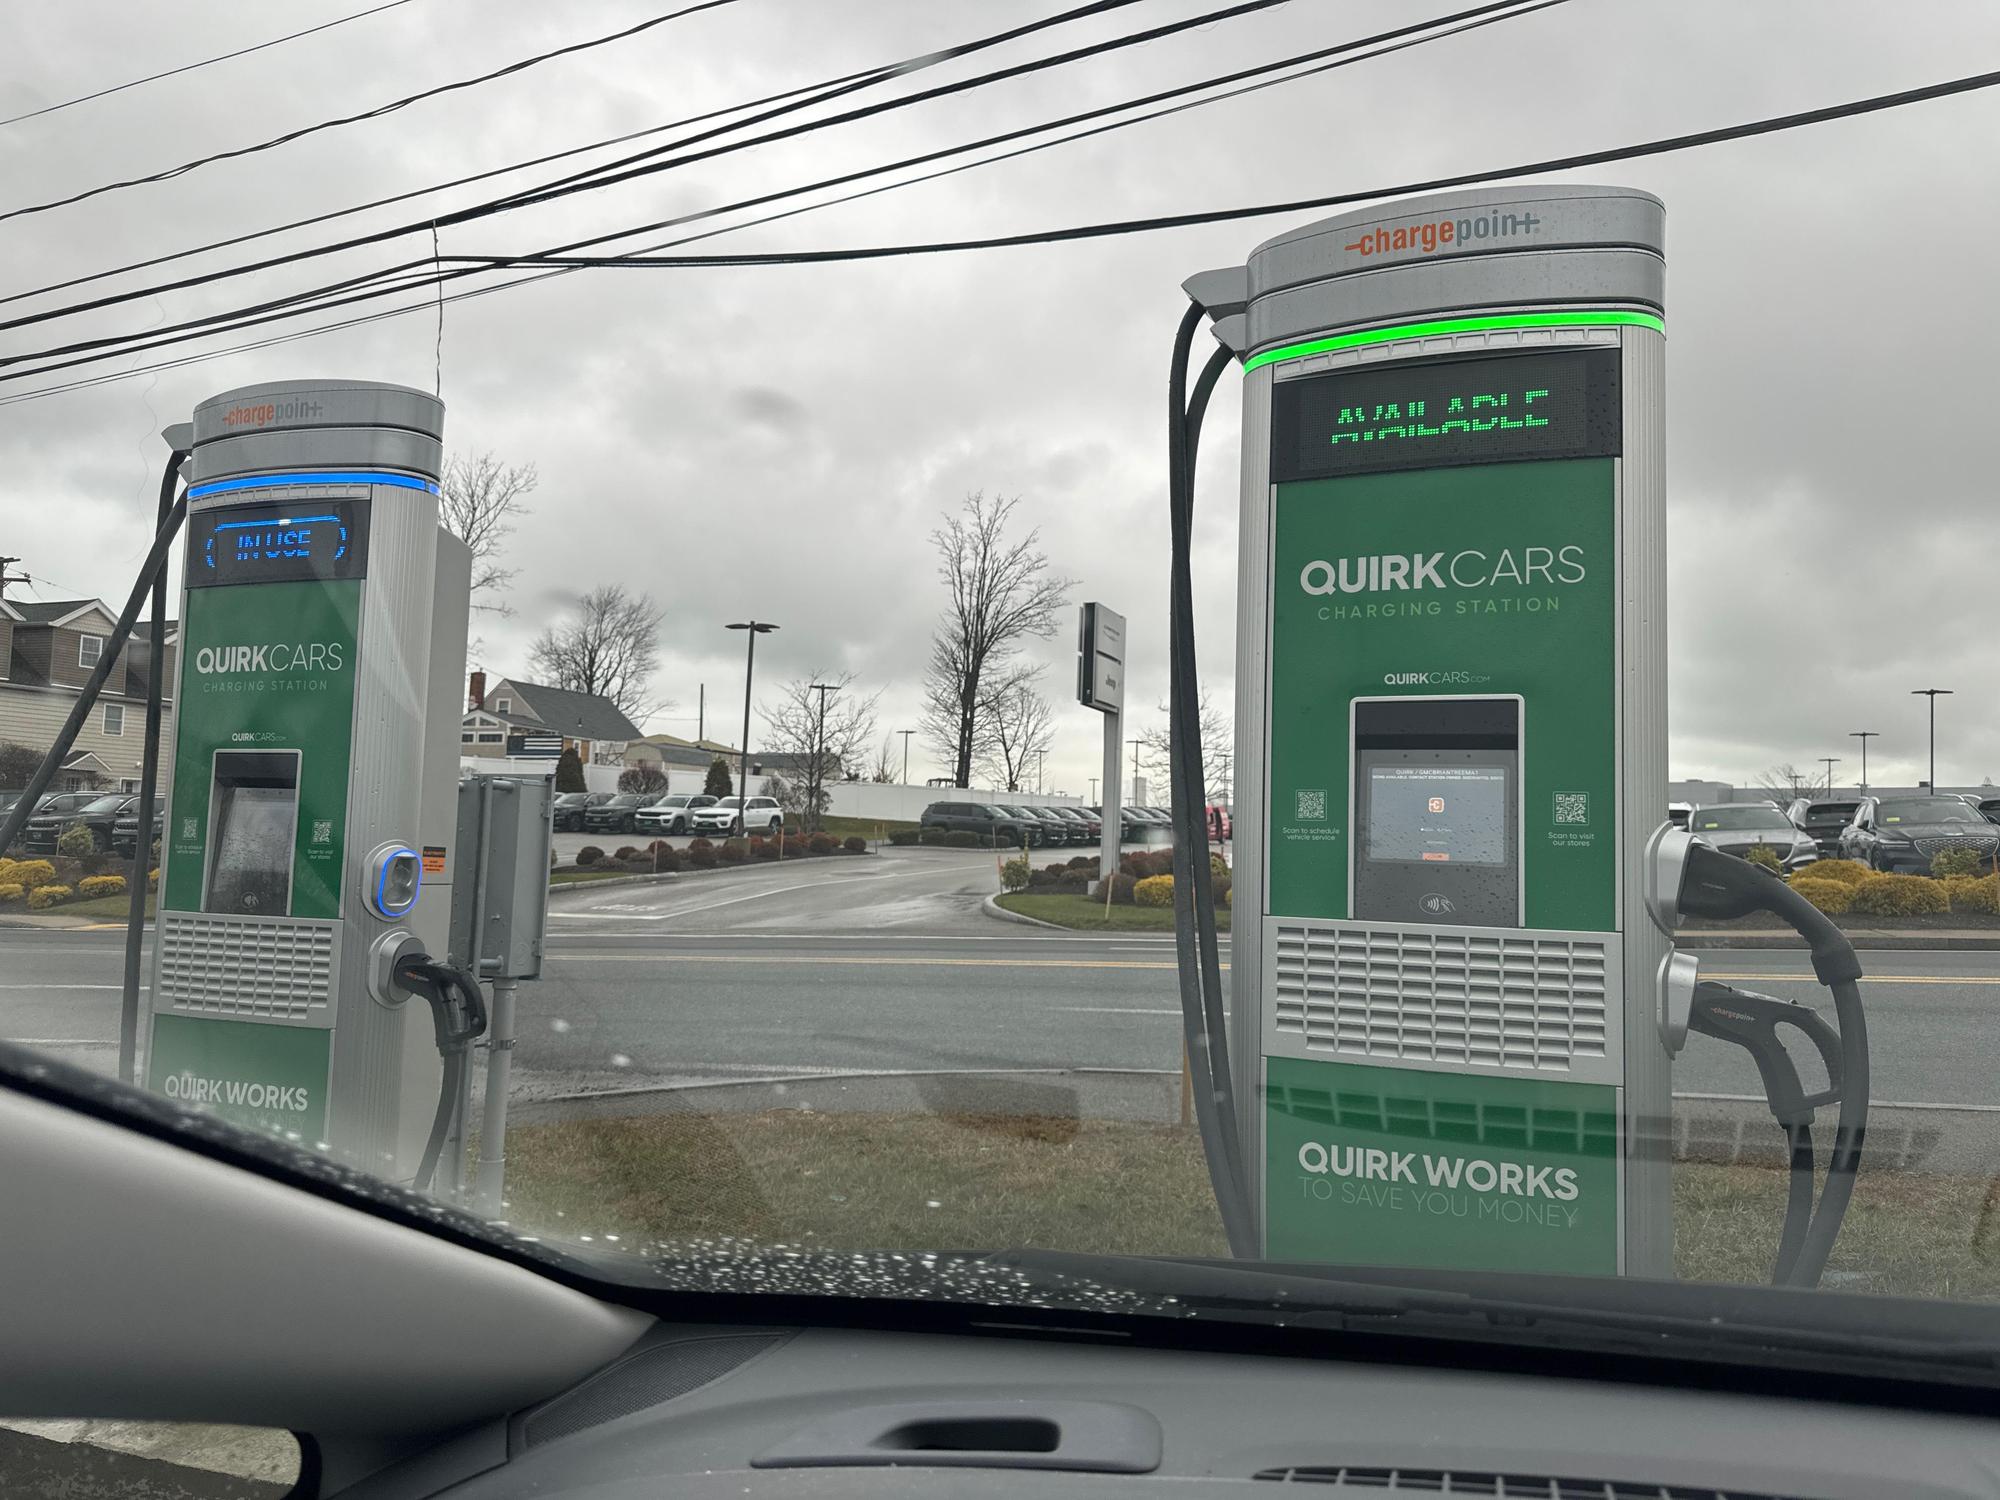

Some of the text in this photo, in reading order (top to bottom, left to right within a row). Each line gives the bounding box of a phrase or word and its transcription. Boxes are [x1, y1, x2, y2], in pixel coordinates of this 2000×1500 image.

[1300, 545, 1586, 596] QUIRKCARS
[1318, 597, 1560, 621] CHARGING STATION
[203, 679, 328, 693] CHARGING STATION
[1547, 831, 1568, 839] Scan
[164, 1075, 309, 1112] QUIRK WORKS
[1298, 1141, 1580, 1201] QUIRK WORKS
[1298, 1176, 1580, 1229] TO SAVE YOU MONEY
